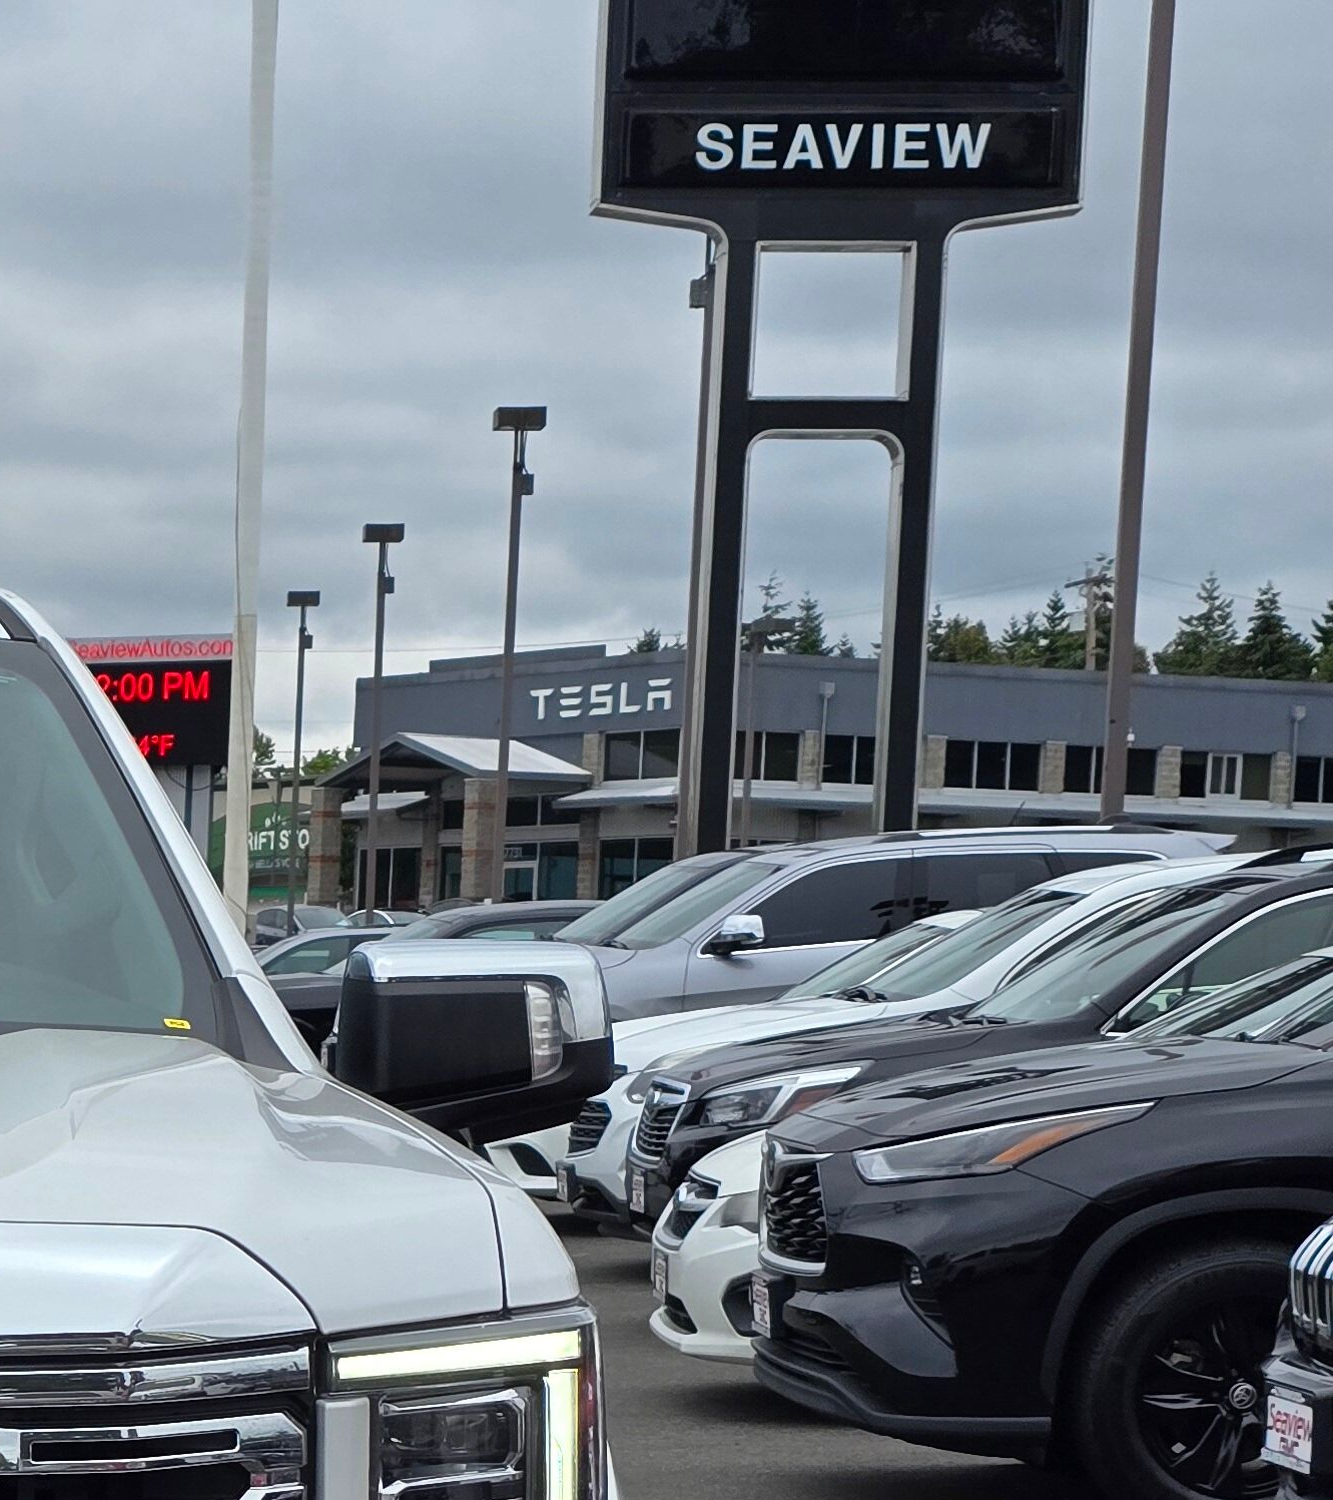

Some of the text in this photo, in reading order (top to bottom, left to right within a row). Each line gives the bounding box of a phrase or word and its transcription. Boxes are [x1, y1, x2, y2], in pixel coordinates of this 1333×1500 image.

[695, 123, 992, 170] SEAVIEW
[163, 671, 210, 700] PM
[529, 678, 673, 720] TESLA
